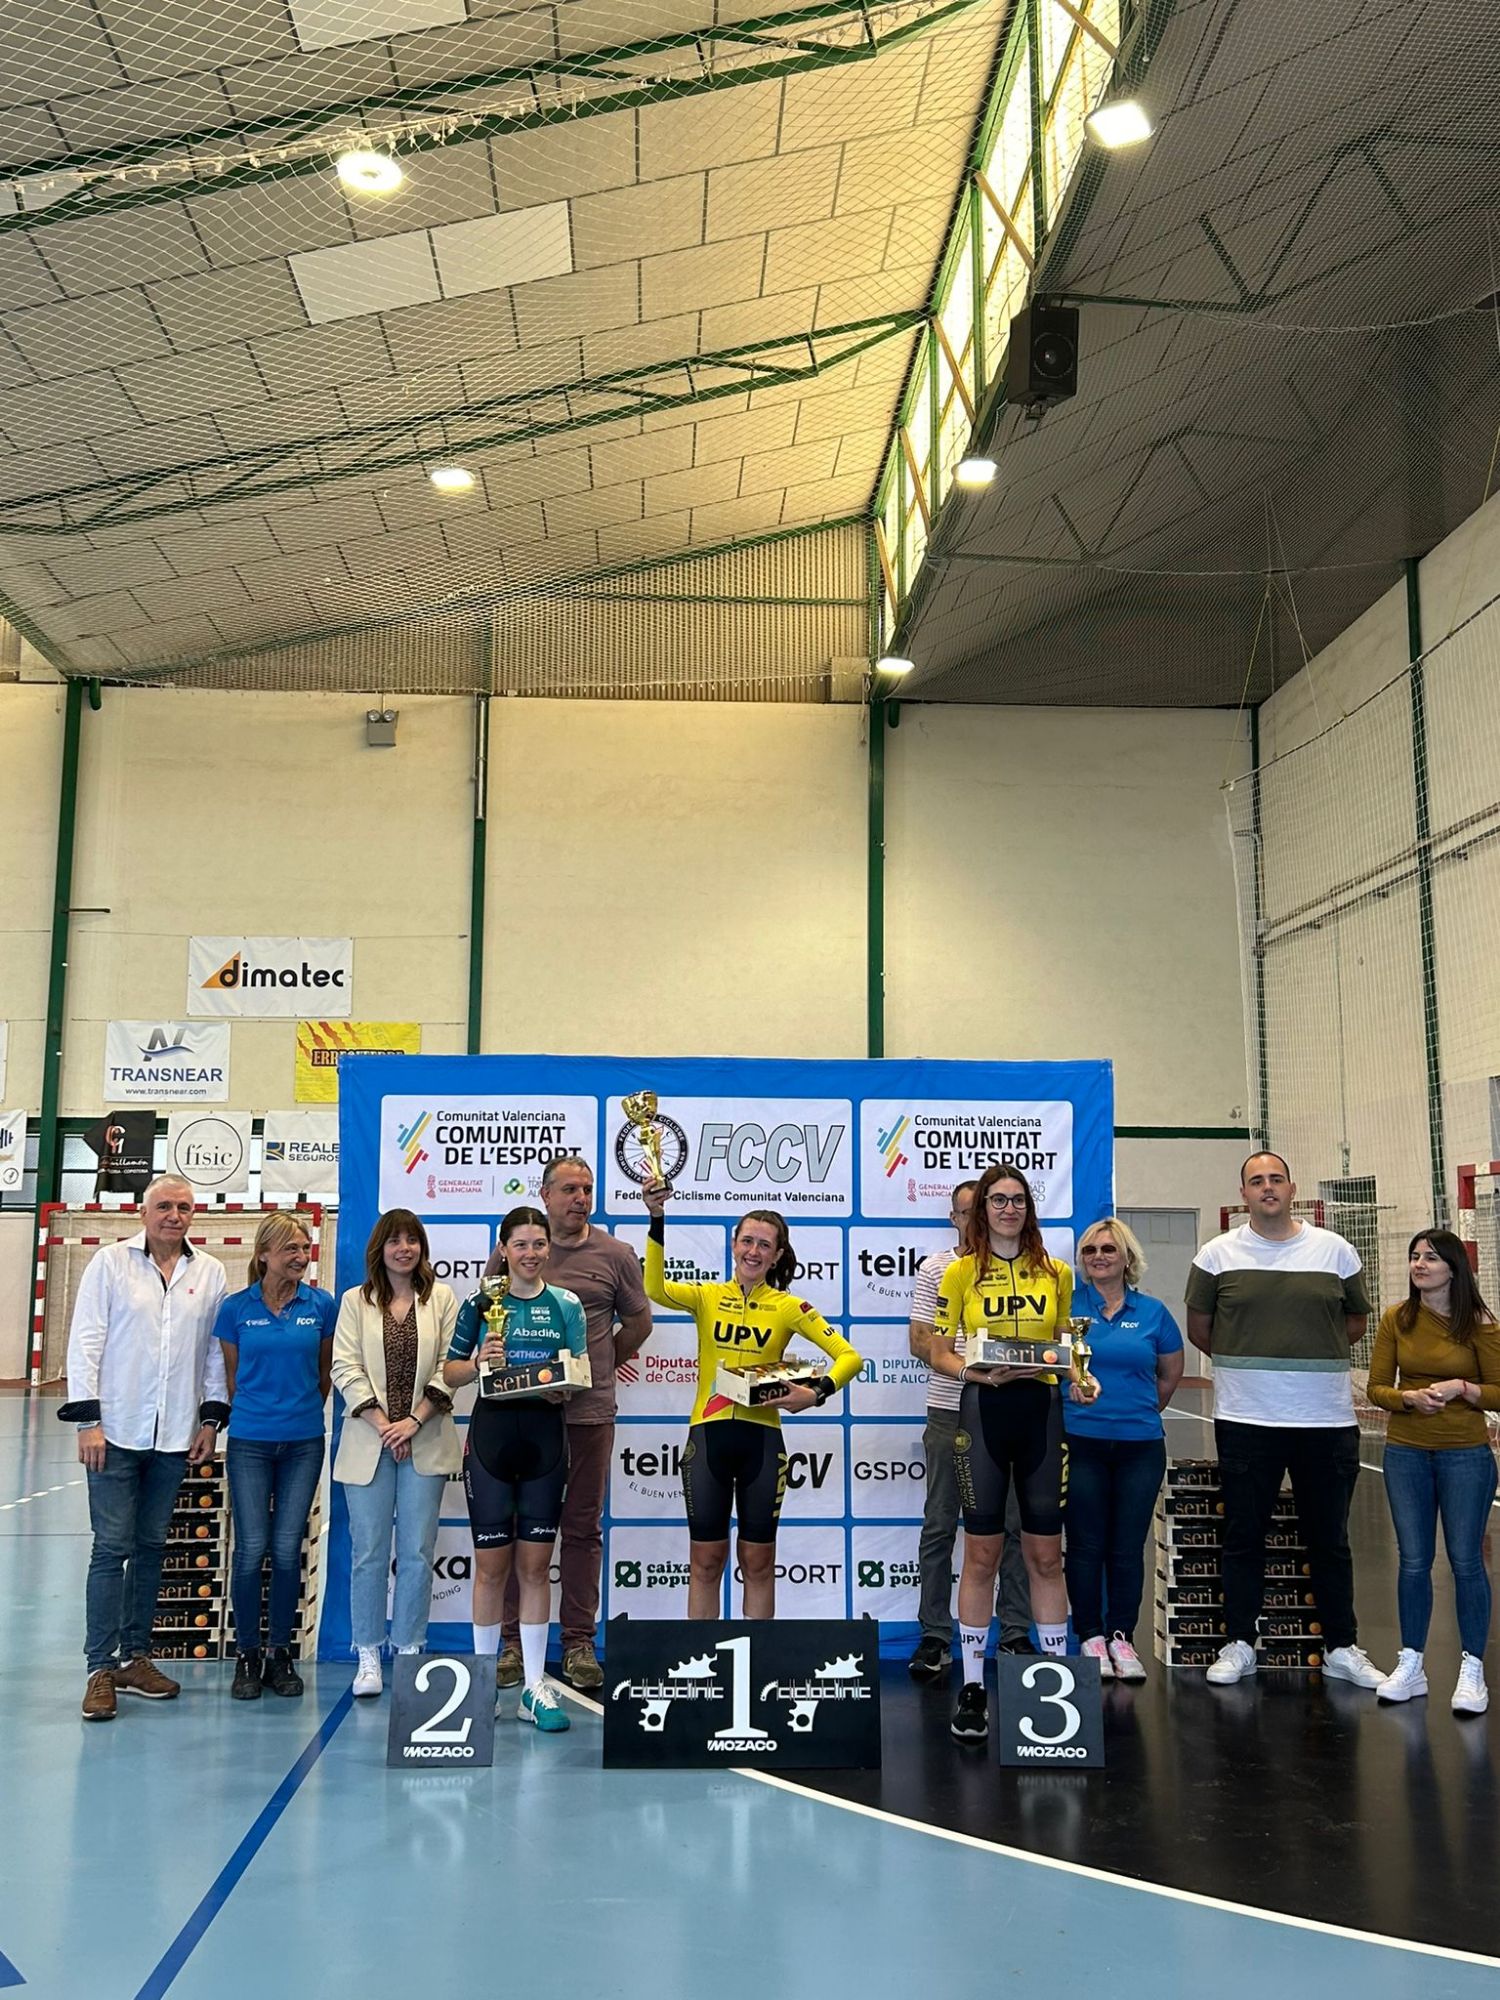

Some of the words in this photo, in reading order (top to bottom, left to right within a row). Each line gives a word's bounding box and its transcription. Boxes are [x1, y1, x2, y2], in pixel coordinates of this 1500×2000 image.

[219, 959, 345, 988] dimatec
[110, 1067, 224, 1082] TRANSNEAR
[125, 1088, 207, 1096] www.transnear.com
[436, 1110, 499, 1122] Comunitat
[502, 1110, 566, 1122] Valenciana
[914, 1114, 976, 1126] Comunitat
[978, 1116, 1042, 1128] Valenciana
[435, 1126, 567, 1144] COMUNITAT
[914, 1130, 1042, 1149] COMUNITAT
[184, 1143, 233, 1166] físic
[289, 1142, 340, 1153] REALE
[445, 1147, 473, 1165] DE
[694, 1122, 846, 1184] FCCV
[288, 1154, 340, 1162] SEGUROS
[924, 1152, 952, 1169] DE
[438, 1179, 484, 1187] GENERALITAT
[673, 1190, 722, 1201] Ciclisme
[724, 1191, 782, 1202] Comunitat
[784, 1192, 845, 1202] Valenciana
[433, 1260, 486, 1278] ORT
[858, 1246, 928, 1277] teik
[663, 1268, 720, 1282] opular
[793, 1262, 840, 1280] ORT
[879, 1287, 901, 1298] BUEN
[984, 1295, 1047, 1317] UPV
[512, 1327, 561, 1339] Abadiño
[714, 1321, 772, 1348] UPV
[506, 1350, 551, 1359] CATHLON
[994, 1345, 1035, 1363] seri
[645, 1355, 699, 1371] Diputac
[883, 1359, 930, 1369] DIPUTAC
[492, 1368, 532, 1393] seri
[645, 1370, 663, 1383] de
[665, 1370, 699, 1383] Cast
[883, 1374, 897, 1383] DE
[758, 1387, 788, 1404] ser
[620, 1443, 682, 1477] teik
[786, 1452, 833, 1489] CV
[854, 1461, 926, 1480] GSPO
[1177, 1469, 1212, 1486] seri
[629, 1481, 638, 1492] EL
[641, 1487, 664, 1499] BUEN
[1175, 1499, 1209, 1515] seri
[1182, 1528, 1217, 1545] seri
[1264, 1530, 1299, 1547] seri
[163, 1552, 190, 1569] eri
[646, 1560, 690, 1573] caixa
[890, 1560, 920, 1573] caix
[1182, 1558, 1217, 1575] seri
[646, 1574, 690, 1588] popu
[734, 1565, 842, 1584] PORT
[432, 1585, 461, 1601] NDING
[1178, 1588, 1212, 1604] seri
[1264, 1589, 1298, 1606] seri
[153, 1611, 189, 1628] seri
[1178, 1618, 1213, 1635] seri
[1268, 1619, 1303, 1636] seri
[151, 1642, 187, 1658] seri
[1181, 1648, 1216, 1665] seri
[1266, 1650, 1302, 1666] seri
[715, 1636, 768, 1738] 1
[410, 1658, 473, 1742] 2
[1018, 1661, 1081, 1745] 3
[403, 1746, 475, 1758] MOZACO
[707, 1740, 777, 1751] MOZACO
[1017, 1745, 1088, 1758] MOZACO
